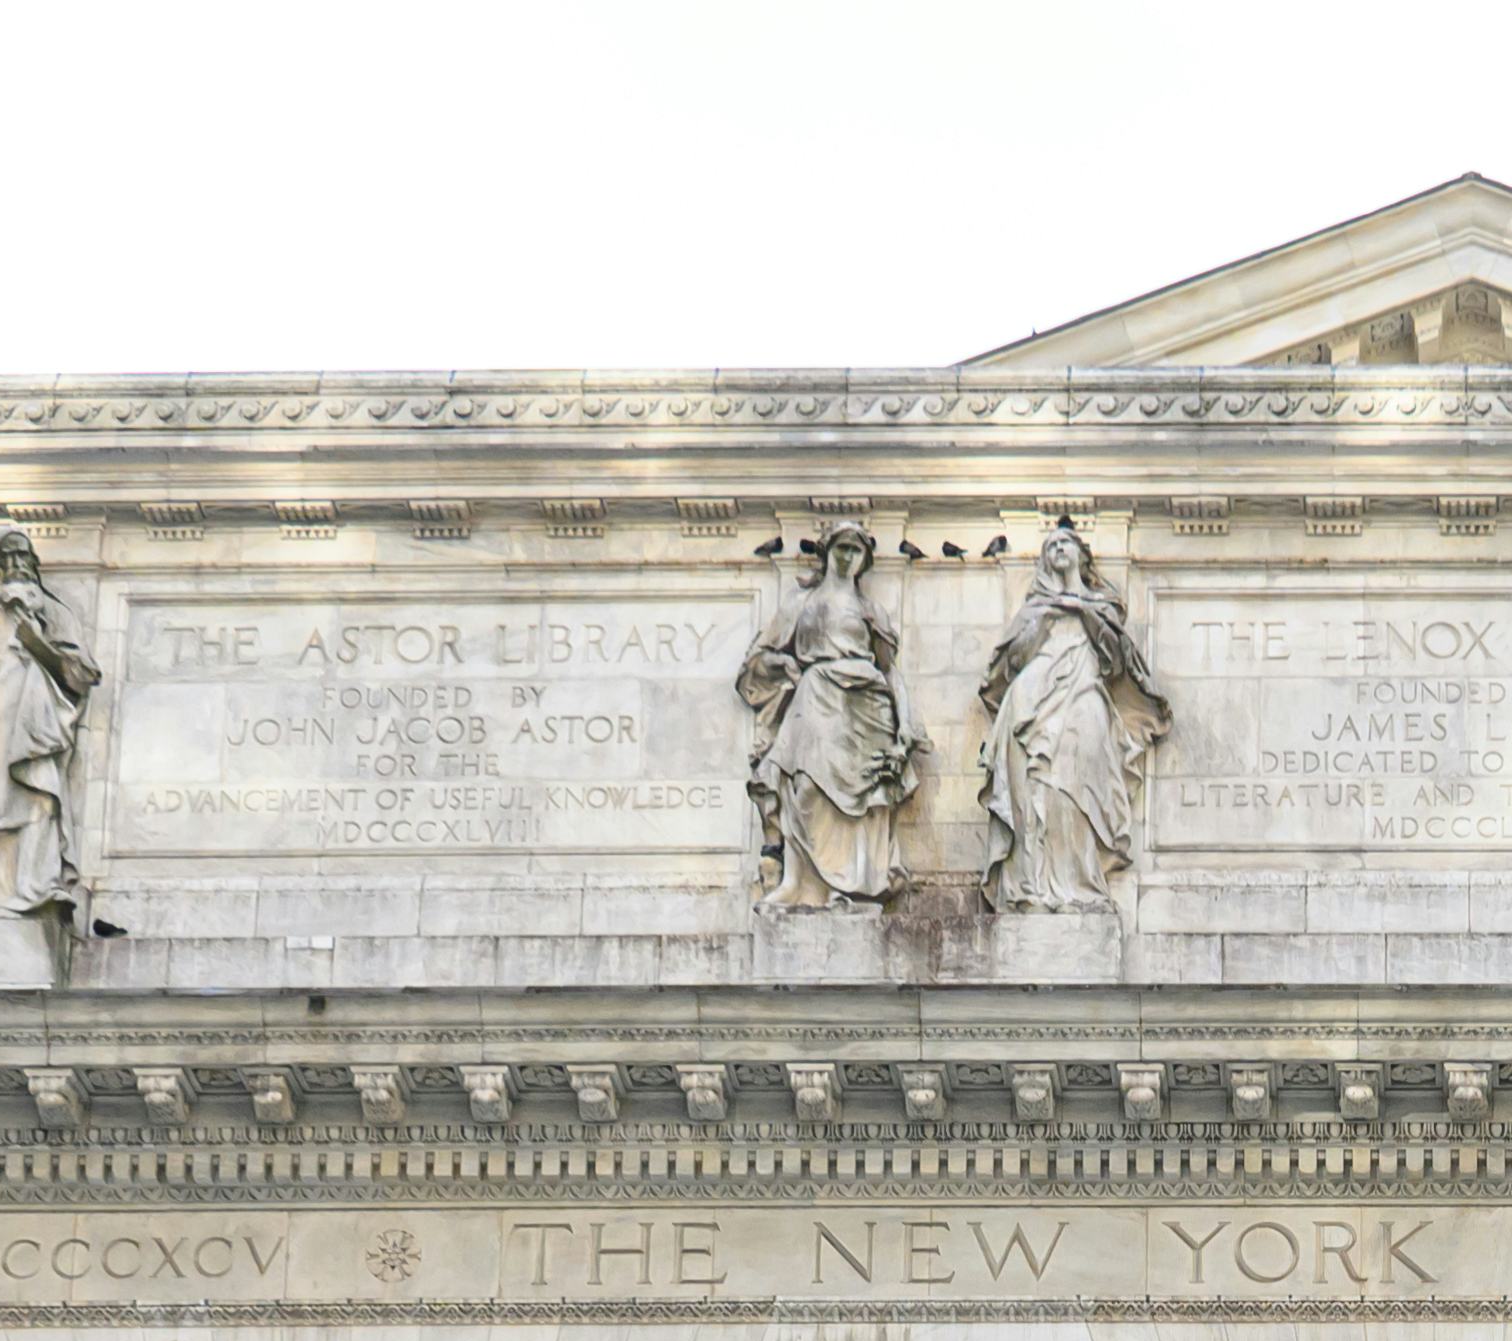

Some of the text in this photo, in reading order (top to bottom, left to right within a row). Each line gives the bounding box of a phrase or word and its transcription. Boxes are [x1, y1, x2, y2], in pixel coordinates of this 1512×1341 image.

[164, 624, 718, 666] THE ASTOR LIBRARY
[1191, 622, 1291, 661] THE
[1321, 621, 1497, 661] LENOX
[322, 686, 548, 710] FOUNDED BY
[1357, 681, 1506, 704] FOUNDED
[227, 715, 638, 747] JOHN JACOB ASTOR
[1312, 713, 1447, 743] JAMES
[356, 754, 500, 777] FOR THE
[1262, 751, 1438, 774] DEDICATED
[1460, 751, 1503, 773] TO
[143, 786, 723, 812] ADVANCEMENT OF USEFUL KNOWLEDGE
[1180, 784, 1384, 807] LITERATURE
[1413, 784, 1474, 806] AND
[514, 1220, 731, 1287] THE
[813, 1220, 1071, 1285] NEW
[1164, 1220, 1438, 1284] YORK
